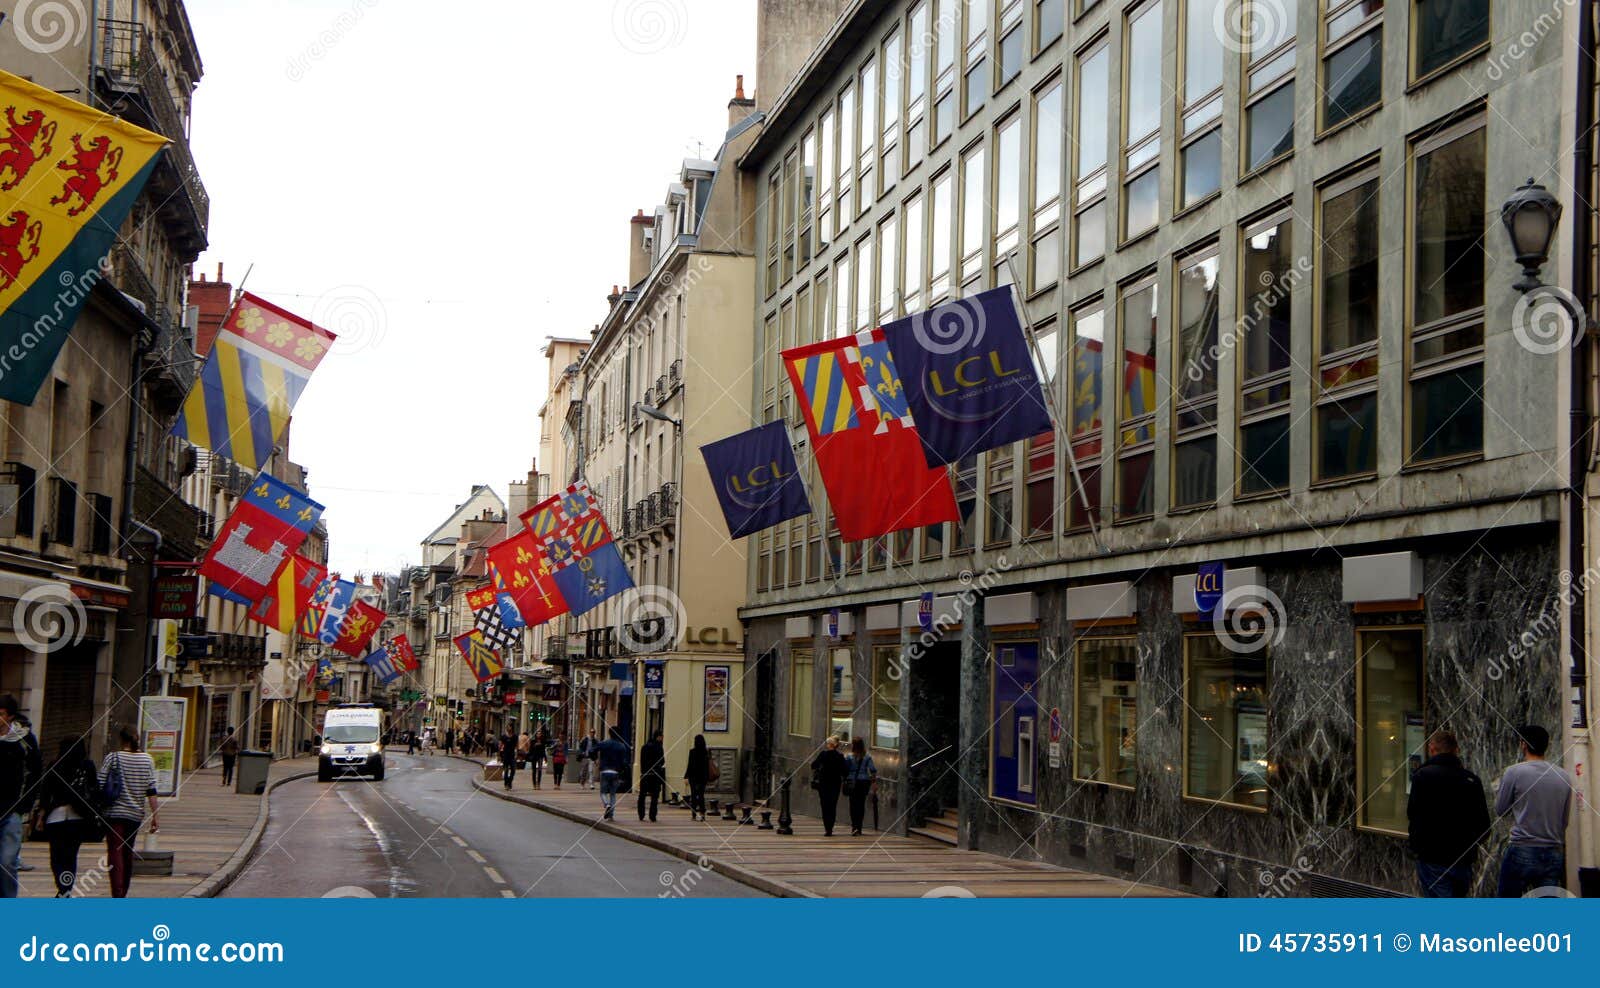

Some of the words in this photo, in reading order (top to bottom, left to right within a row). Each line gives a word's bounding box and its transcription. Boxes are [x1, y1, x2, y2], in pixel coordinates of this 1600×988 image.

[929, 350, 1020, 397] LCL
[731, 460, 791, 493] LCL
[1196, 573, 1220, 592] LCL
[687, 626, 738, 645] LCL
